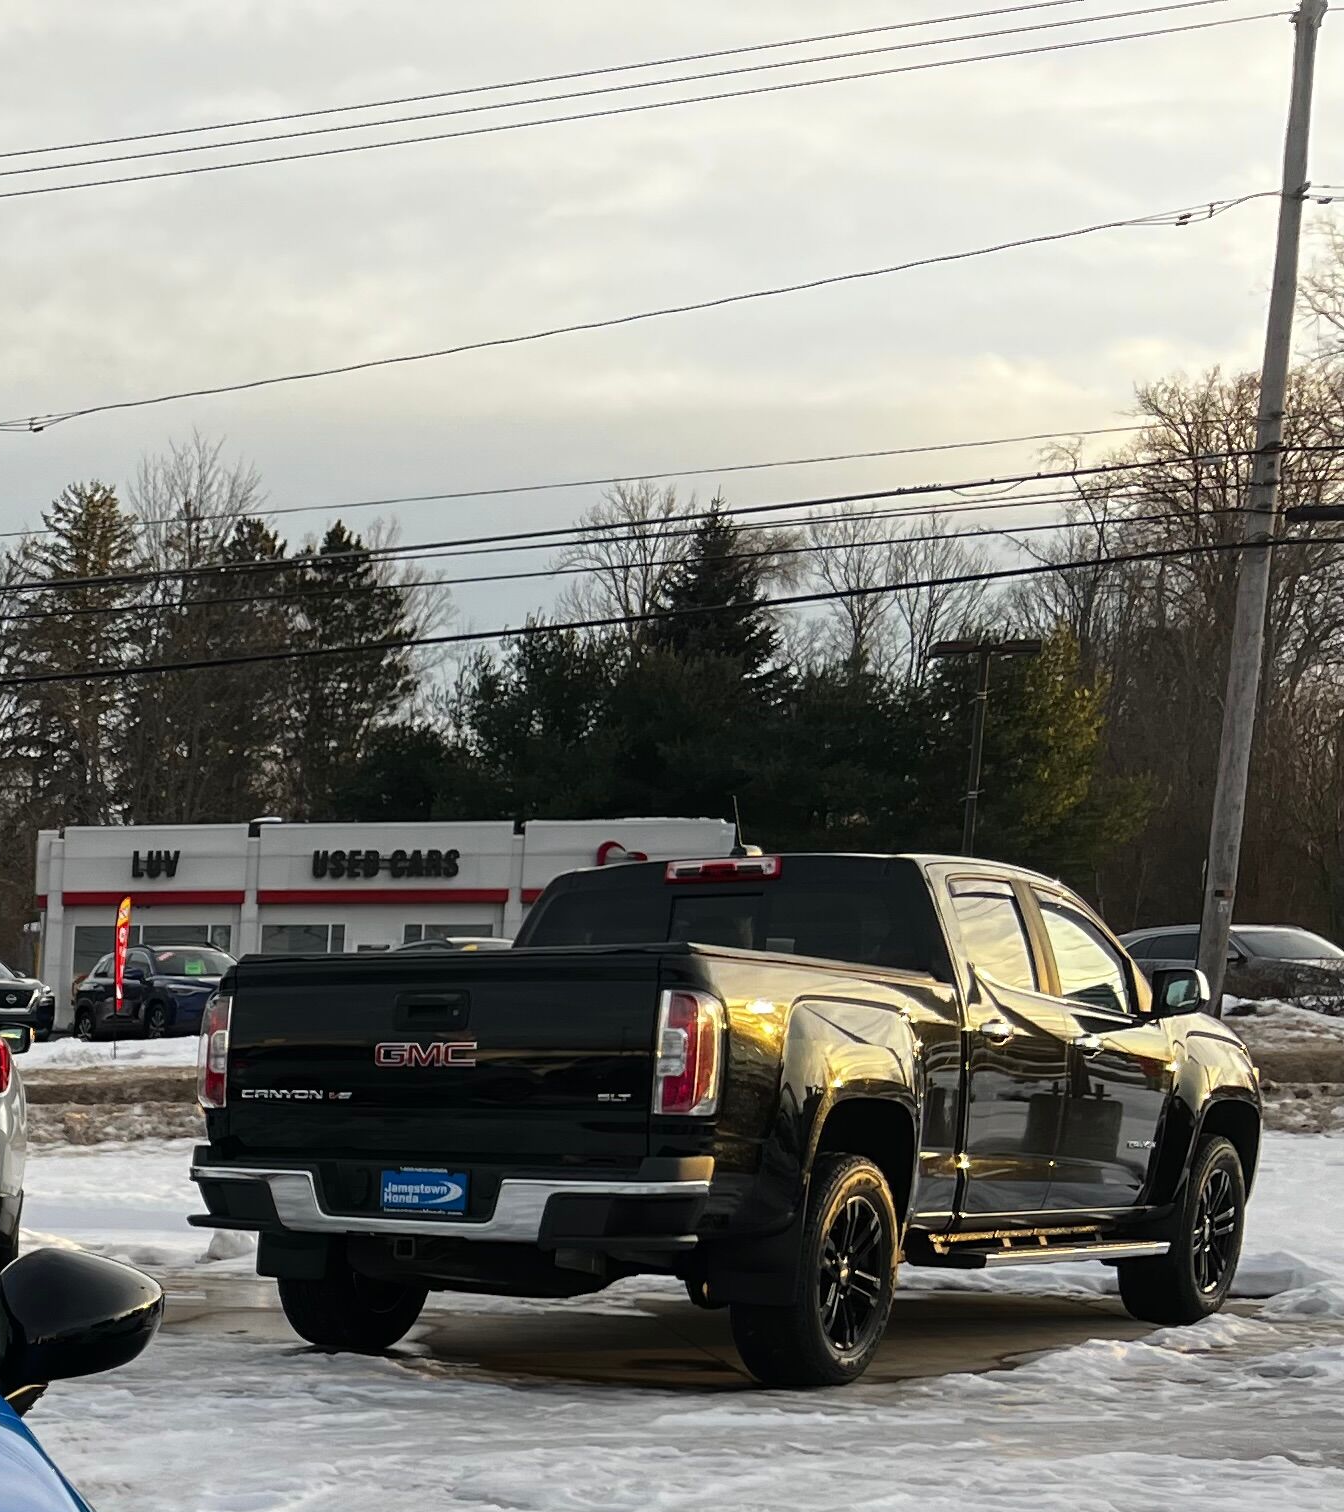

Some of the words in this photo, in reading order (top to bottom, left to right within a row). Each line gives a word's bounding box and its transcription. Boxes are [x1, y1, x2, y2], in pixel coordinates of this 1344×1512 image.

[131, 850, 180, 878] LUV
[312, 850, 380, 879] USED
[390, 850, 460, 879] CARS
[375, 1042, 478, 1067] GMC
[241, 1089, 324, 1100] CANYON
[384, 1182, 448, 1195] Jamestown
[384, 1192, 419, 1204] Honda
